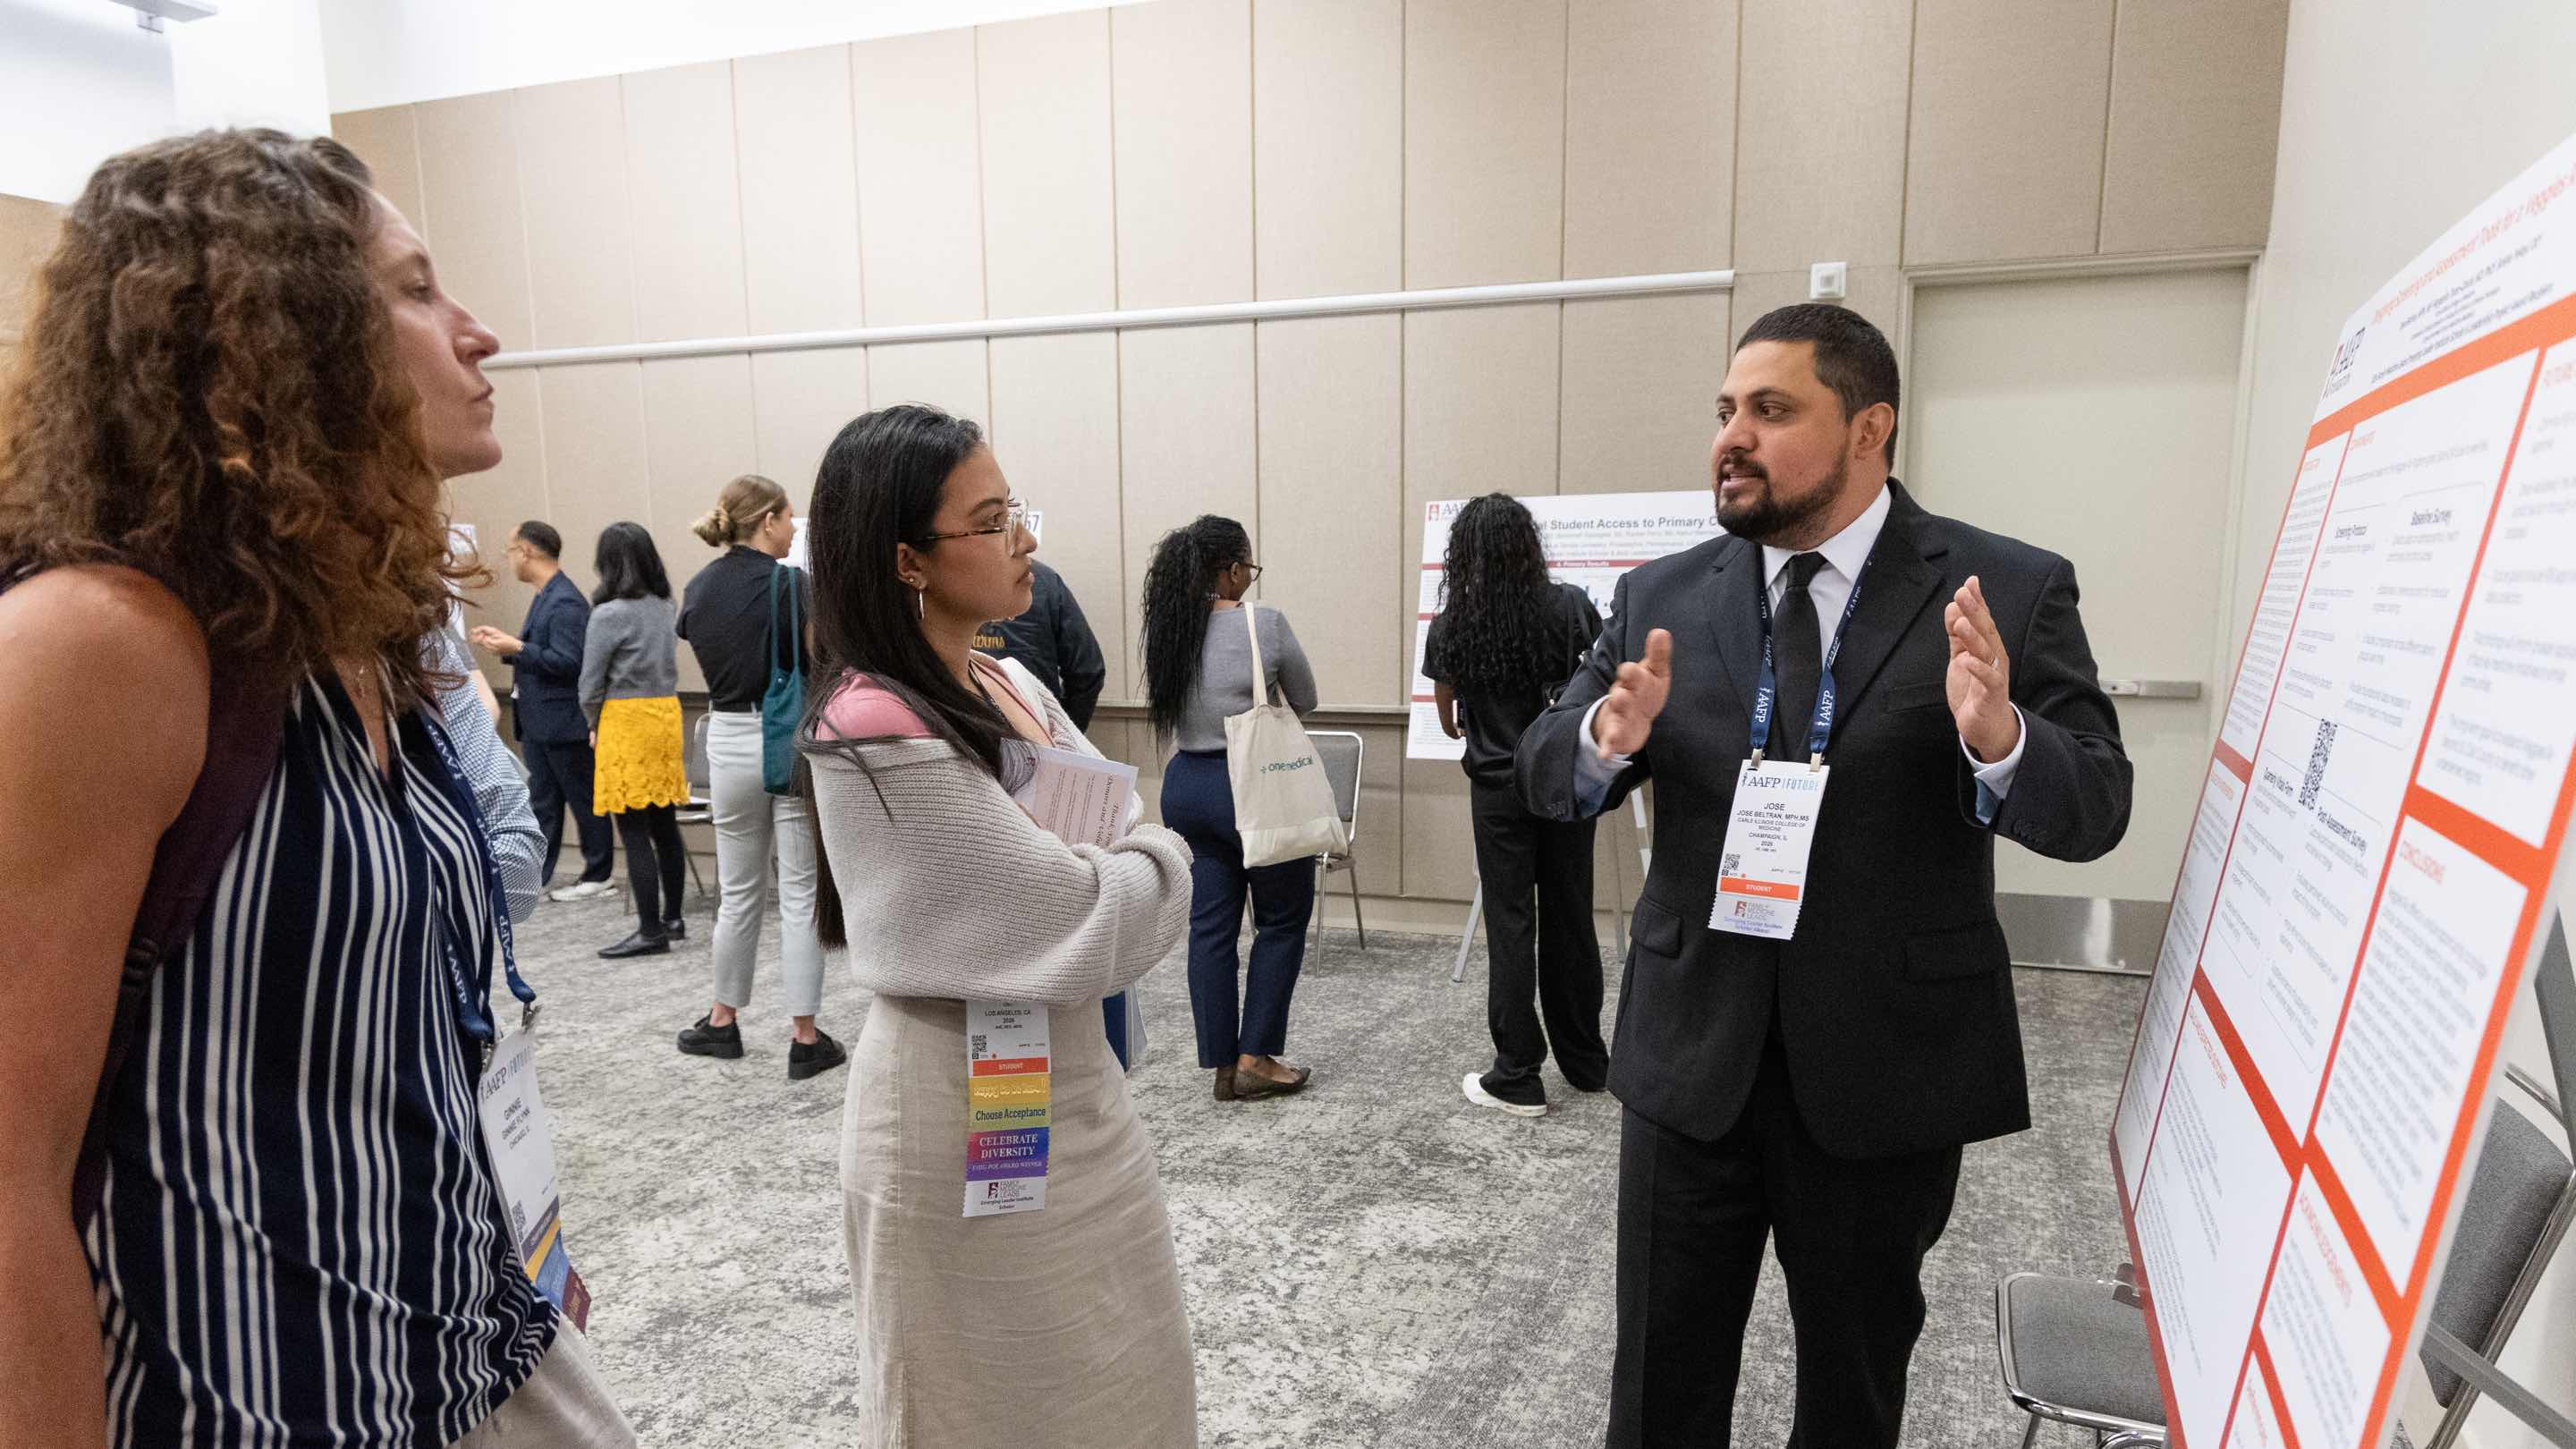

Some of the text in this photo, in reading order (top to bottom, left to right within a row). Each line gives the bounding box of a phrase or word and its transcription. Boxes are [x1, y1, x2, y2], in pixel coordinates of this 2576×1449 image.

[1550, 519, 1594, 530] Student
[1597, 518, 1640, 530] Access
[1642, 518, 1655, 529] to
[1658, 516, 1705, 530] Primary
[1755, 692, 1769, 723] AAFP
[1819, 690, 1834, 721] AAFP
[1748, 775, 1782, 788] AAFP
[1763, 802, 1786, 811] JOSE
[1745, 884, 1773, 893] STUDENT
[486, 1066, 507, 1099] AAFP
[976, 1107, 1046, 1122] Choose Acceptance
[979, 1133, 1038, 1148] CELEBRATE
[980, 1146, 1035, 1159] DIVERSITY
